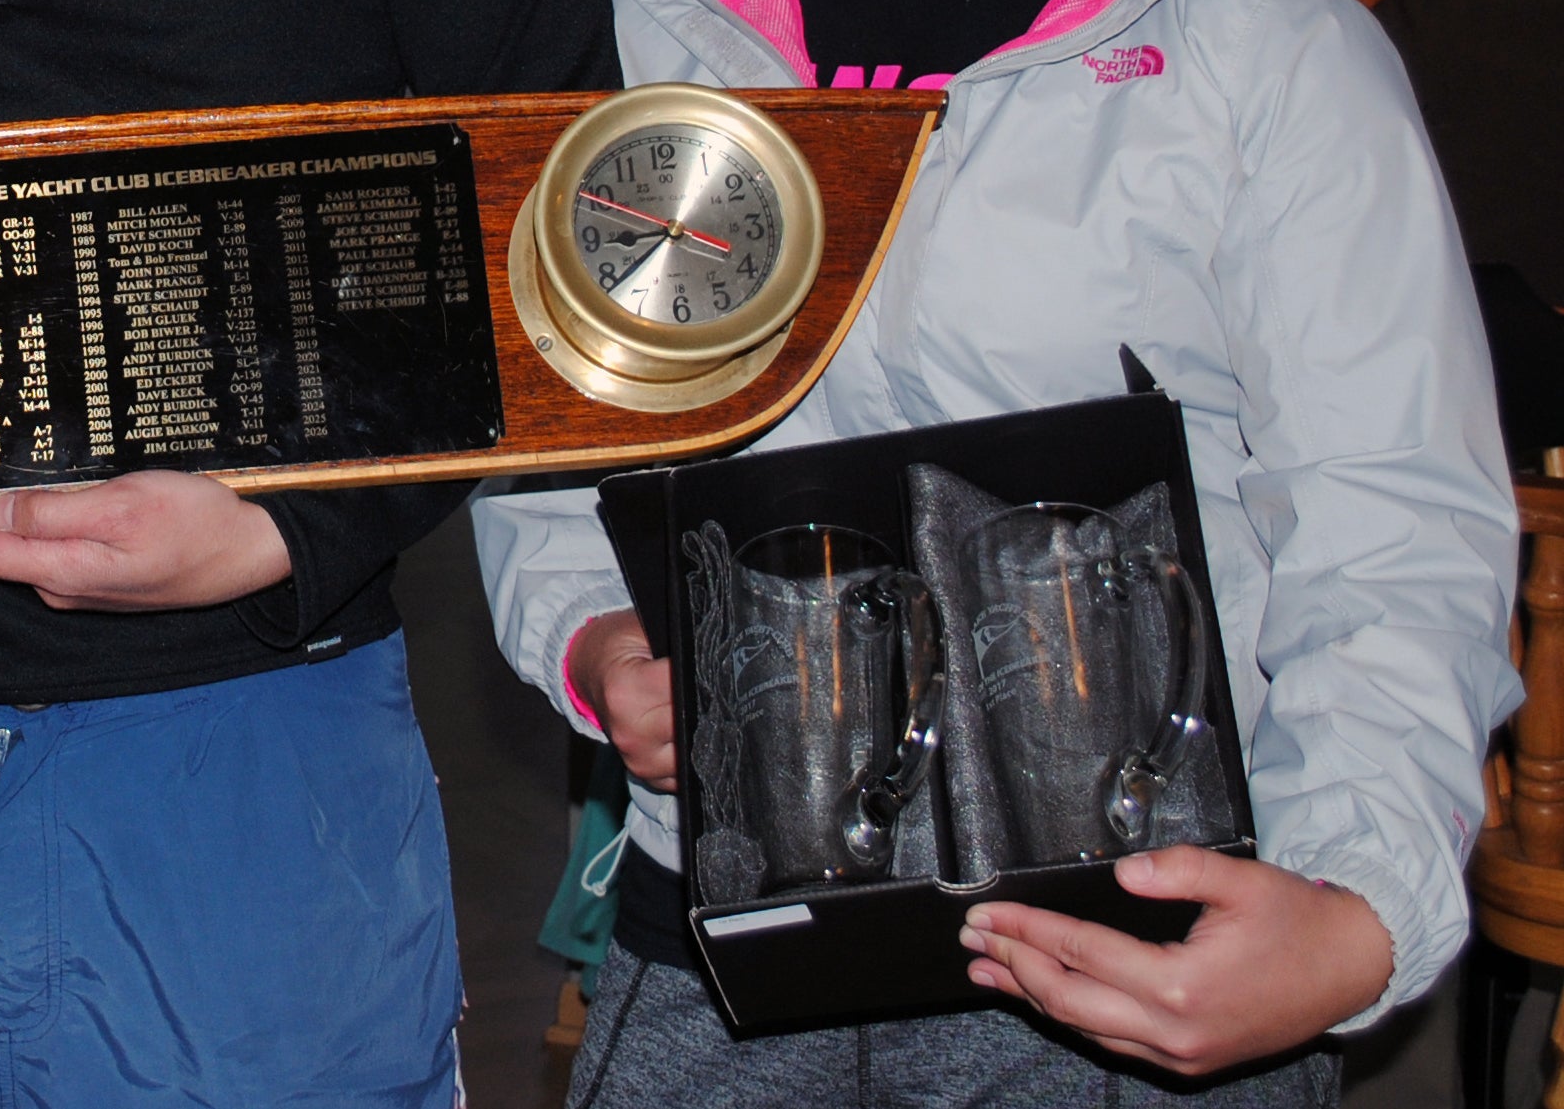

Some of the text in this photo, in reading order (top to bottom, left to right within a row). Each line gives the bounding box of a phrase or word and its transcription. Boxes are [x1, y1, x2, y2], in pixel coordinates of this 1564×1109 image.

[1082, 53, 1138, 72] NORTH
[1112, 46, 1140, 59] THE
[1095, 70, 1135, 84] FACE
[651, 144, 677, 170] 12
[701, 152, 709, 175] 1
[11, 178, 86, 199] YACHT
[91, 173, 149, 192] CLUB
[154, 161, 297, 187] ICEBREAKER
[302, 150, 437, 174] CHAMPIONS
[615, 157, 636, 182] 11
[277, 185, 410, 205] 2007 SAM ROGERS
[725, 173, 745, 201] 2
[589, 185, 614, 211] 10
[1, 216, 34, 228] GR-12
[71, 210, 244, 234] 1988 MITCH MOYLAN V-36
[745, 213, 764, 239] 3
[1, 228, 35, 240] OO-69
[283, 231, 420, 253] 2011 MARK PRANGE
[582, 226, 600, 253] 9
[11, 240, 35, 252] V-31
[12, 252, 36, 264] V-31
[74, 246, 248, 270] 1991 Tom & Bob Frentzel V-70
[737, 253, 758, 279] 4
[13, 264, 37, 276] V-31
[75, 258, 249, 283] 1992 JOHN DENNIS M-14
[287, 269, 428, 289] 2014 DAVE DAVENPORT
[599, 262, 617, 289] 8
[674, 284, 685, 293] 18
[713, 282, 730, 310] 5
[631, 289, 648, 316] 7
[673, 296, 691, 322] 6
[27, 313, 42, 324] I-5
[19, 325, 44, 337] E-88
[81, 332, 104, 344] 1997
[123, 328, 148, 340] BOB
[150, 325, 191, 338] BIWER
[225, 319, 256, 332] V-222
[17, 337, 46, 350] M-14
[22, 350, 46, 362] E-88
[28, 362, 46, 373] E-1
[83, 369, 108, 381] 2000
[122, 364, 163, 378] BRETT
[164, 360, 214, 374] HATTON
[22, 374, 48, 386] D-12
[84, 368, 262, 393] 2001 ED ECKERT A-136
[17, 387, 48, 399] V-101
[85, 381, 263, 406] 2002 DAVE KECK OO-99
[23, 399, 50, 411] M-44
[32, 425, 52, 436] A-7
[33, 437, 53, 448] A-7
[30, 449, 54, 461] T-17
